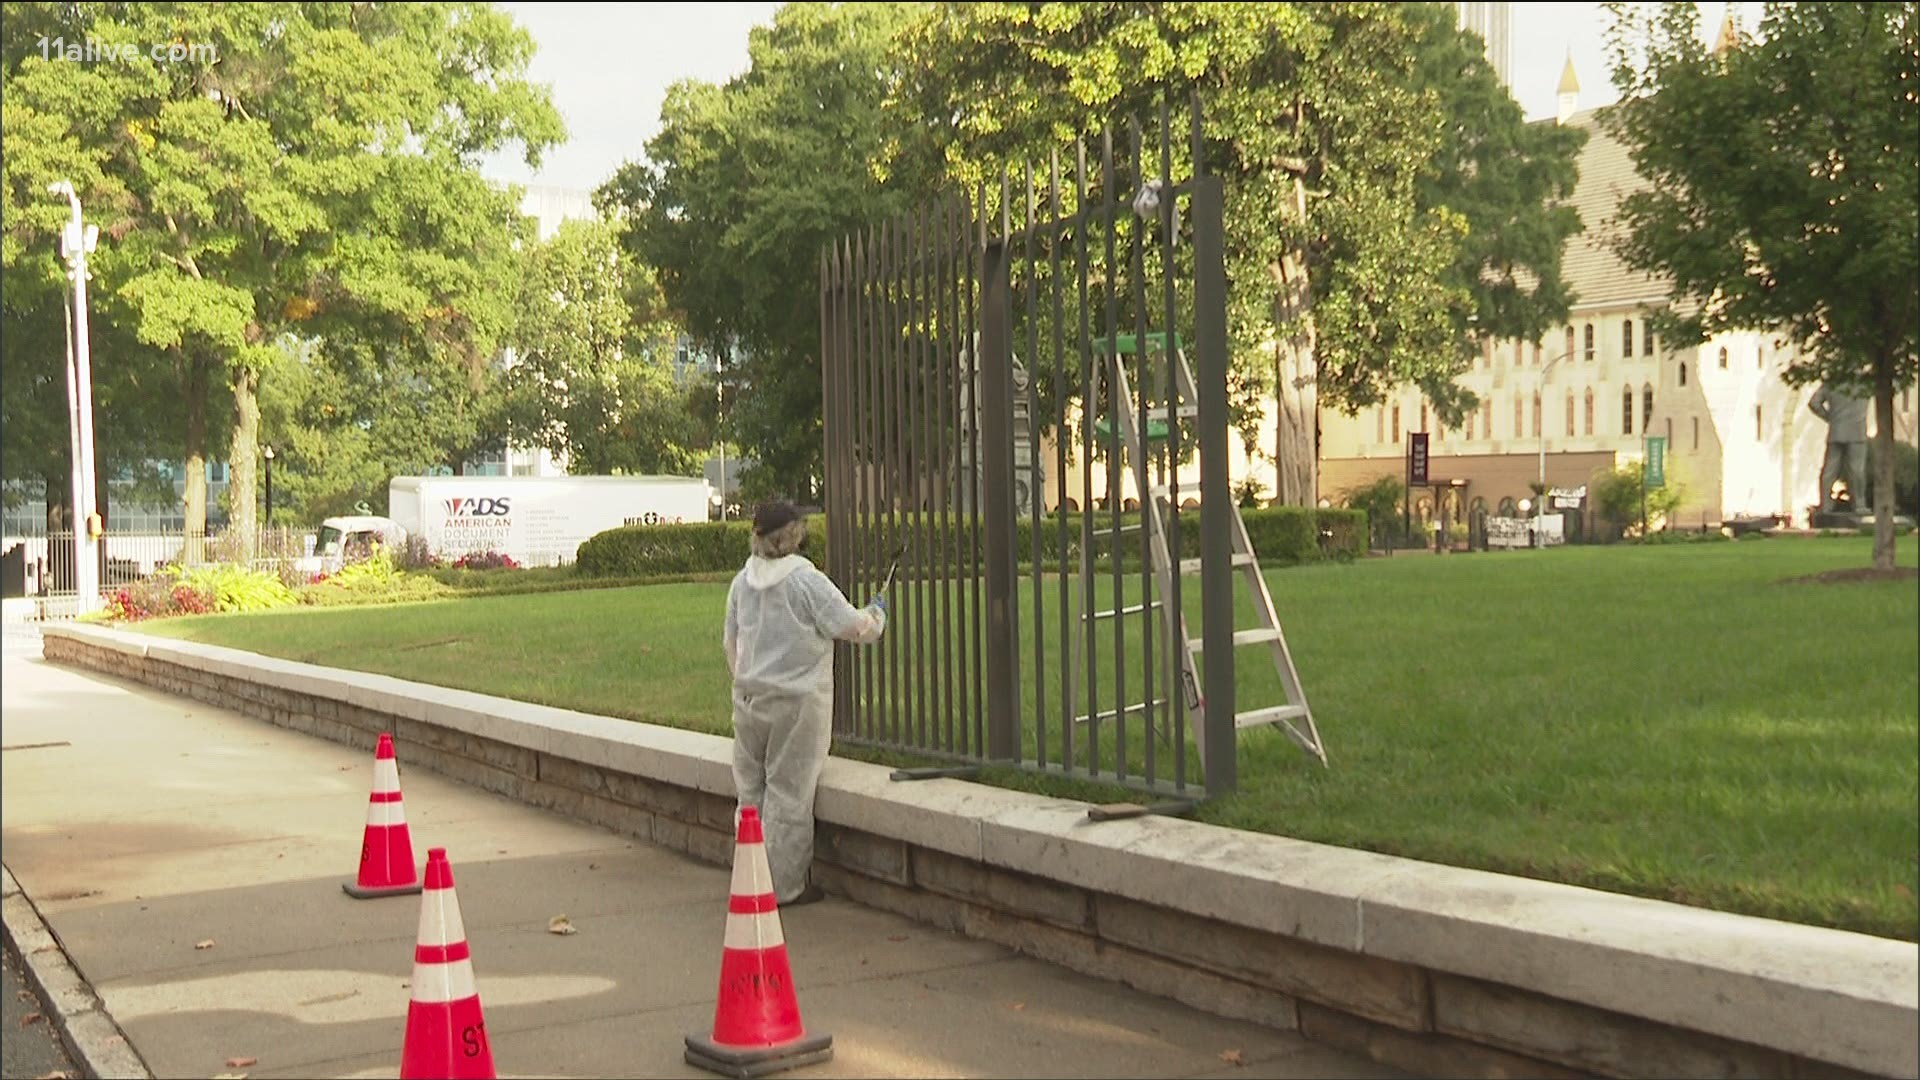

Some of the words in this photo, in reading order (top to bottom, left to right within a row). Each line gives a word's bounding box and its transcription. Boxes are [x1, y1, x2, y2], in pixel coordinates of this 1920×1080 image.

[459, 497, 511, 516] ADS
[445, 518, 512, 528] AMERICAN
[444, 529, 511, 538] DOCUMENT
